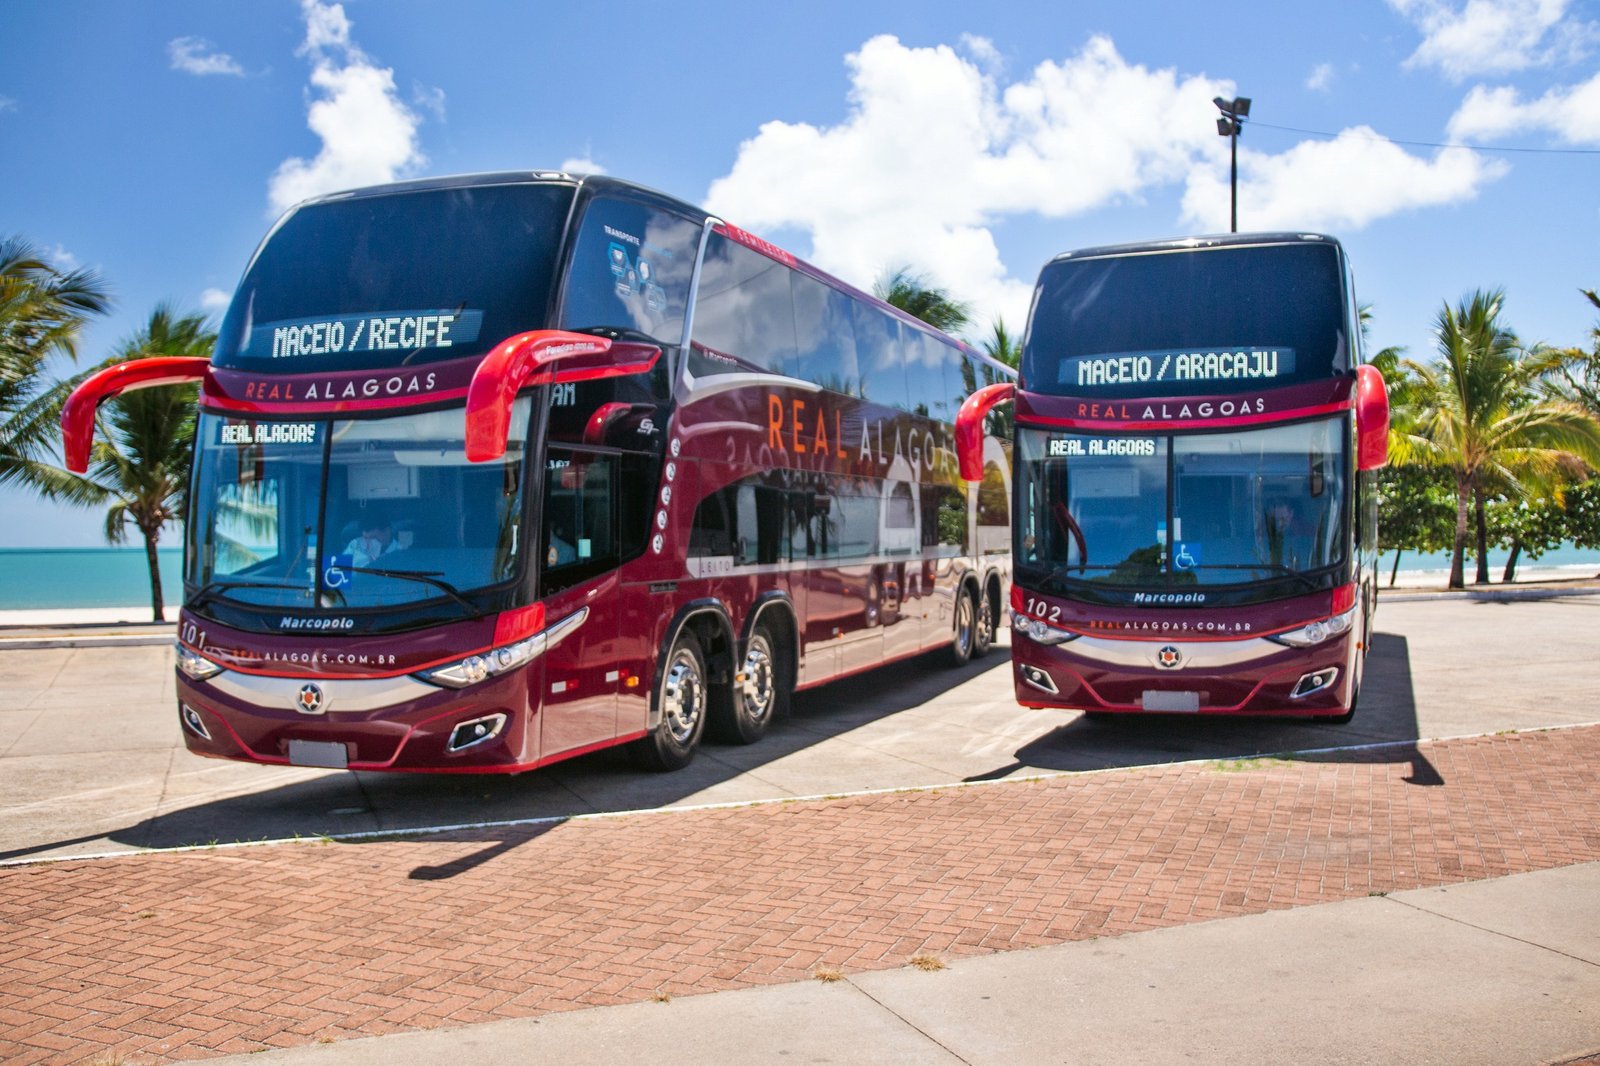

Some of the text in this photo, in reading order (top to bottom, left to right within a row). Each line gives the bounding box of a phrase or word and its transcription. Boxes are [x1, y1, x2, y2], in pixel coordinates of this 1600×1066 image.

[604, 225, 640, 246] TRANSPORTE
[272, 321, 345, 358] MACEIO
[368, 315, 454, 350] RECIFE
[1078, 356, 1151, 386] MACEIO
[1175, 351, 1278, 379] ARACAJU
[245, 372, 436, 399] REAL ALAGOAS
[1078, 398, 1265, 420] REAL ALAGOAS
[221, 423, 316, 444] REAL ALAGOAS
[768, 393, 847, 458] REAL
[1050, 439, 1155, 456] REAL ALAGOAS
[1134, 592, 1206, 603] Marcopolo
[1027, 598, 1061, 623] 102
[280, 616, 354, 630] Marcopolo
[182, 621, 206, 650] 101
